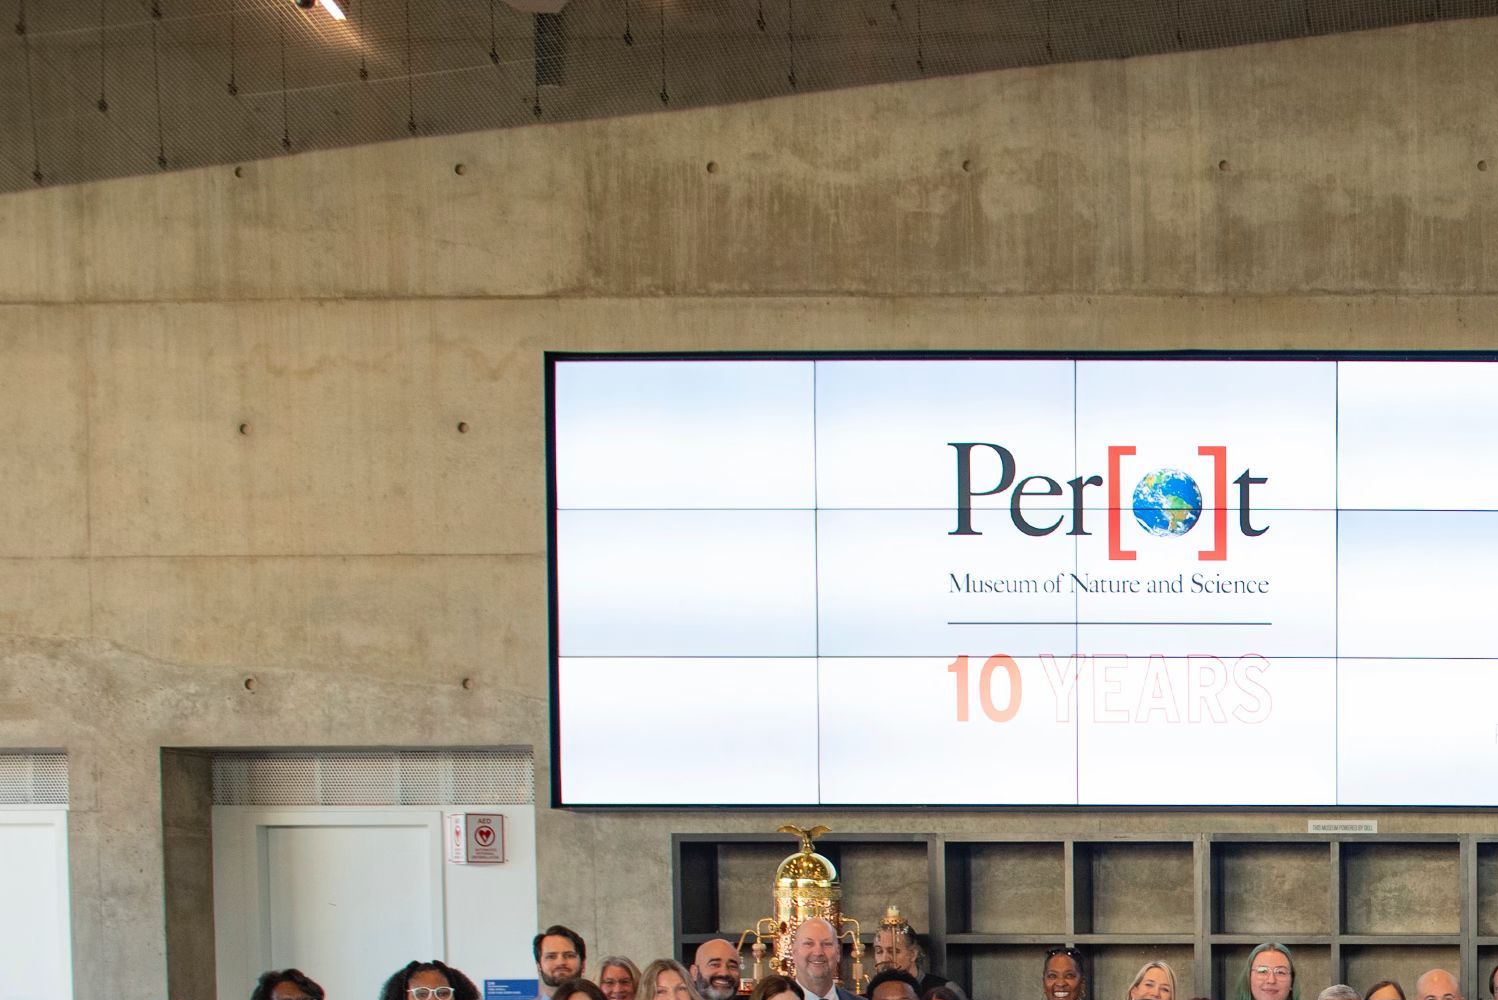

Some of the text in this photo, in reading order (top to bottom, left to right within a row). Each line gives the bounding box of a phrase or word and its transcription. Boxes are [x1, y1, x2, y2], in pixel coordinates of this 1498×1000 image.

[949, 572, 1270, 594] Museum of Nature and Science
[947, 652, 1273, 724] 10 YEARS
